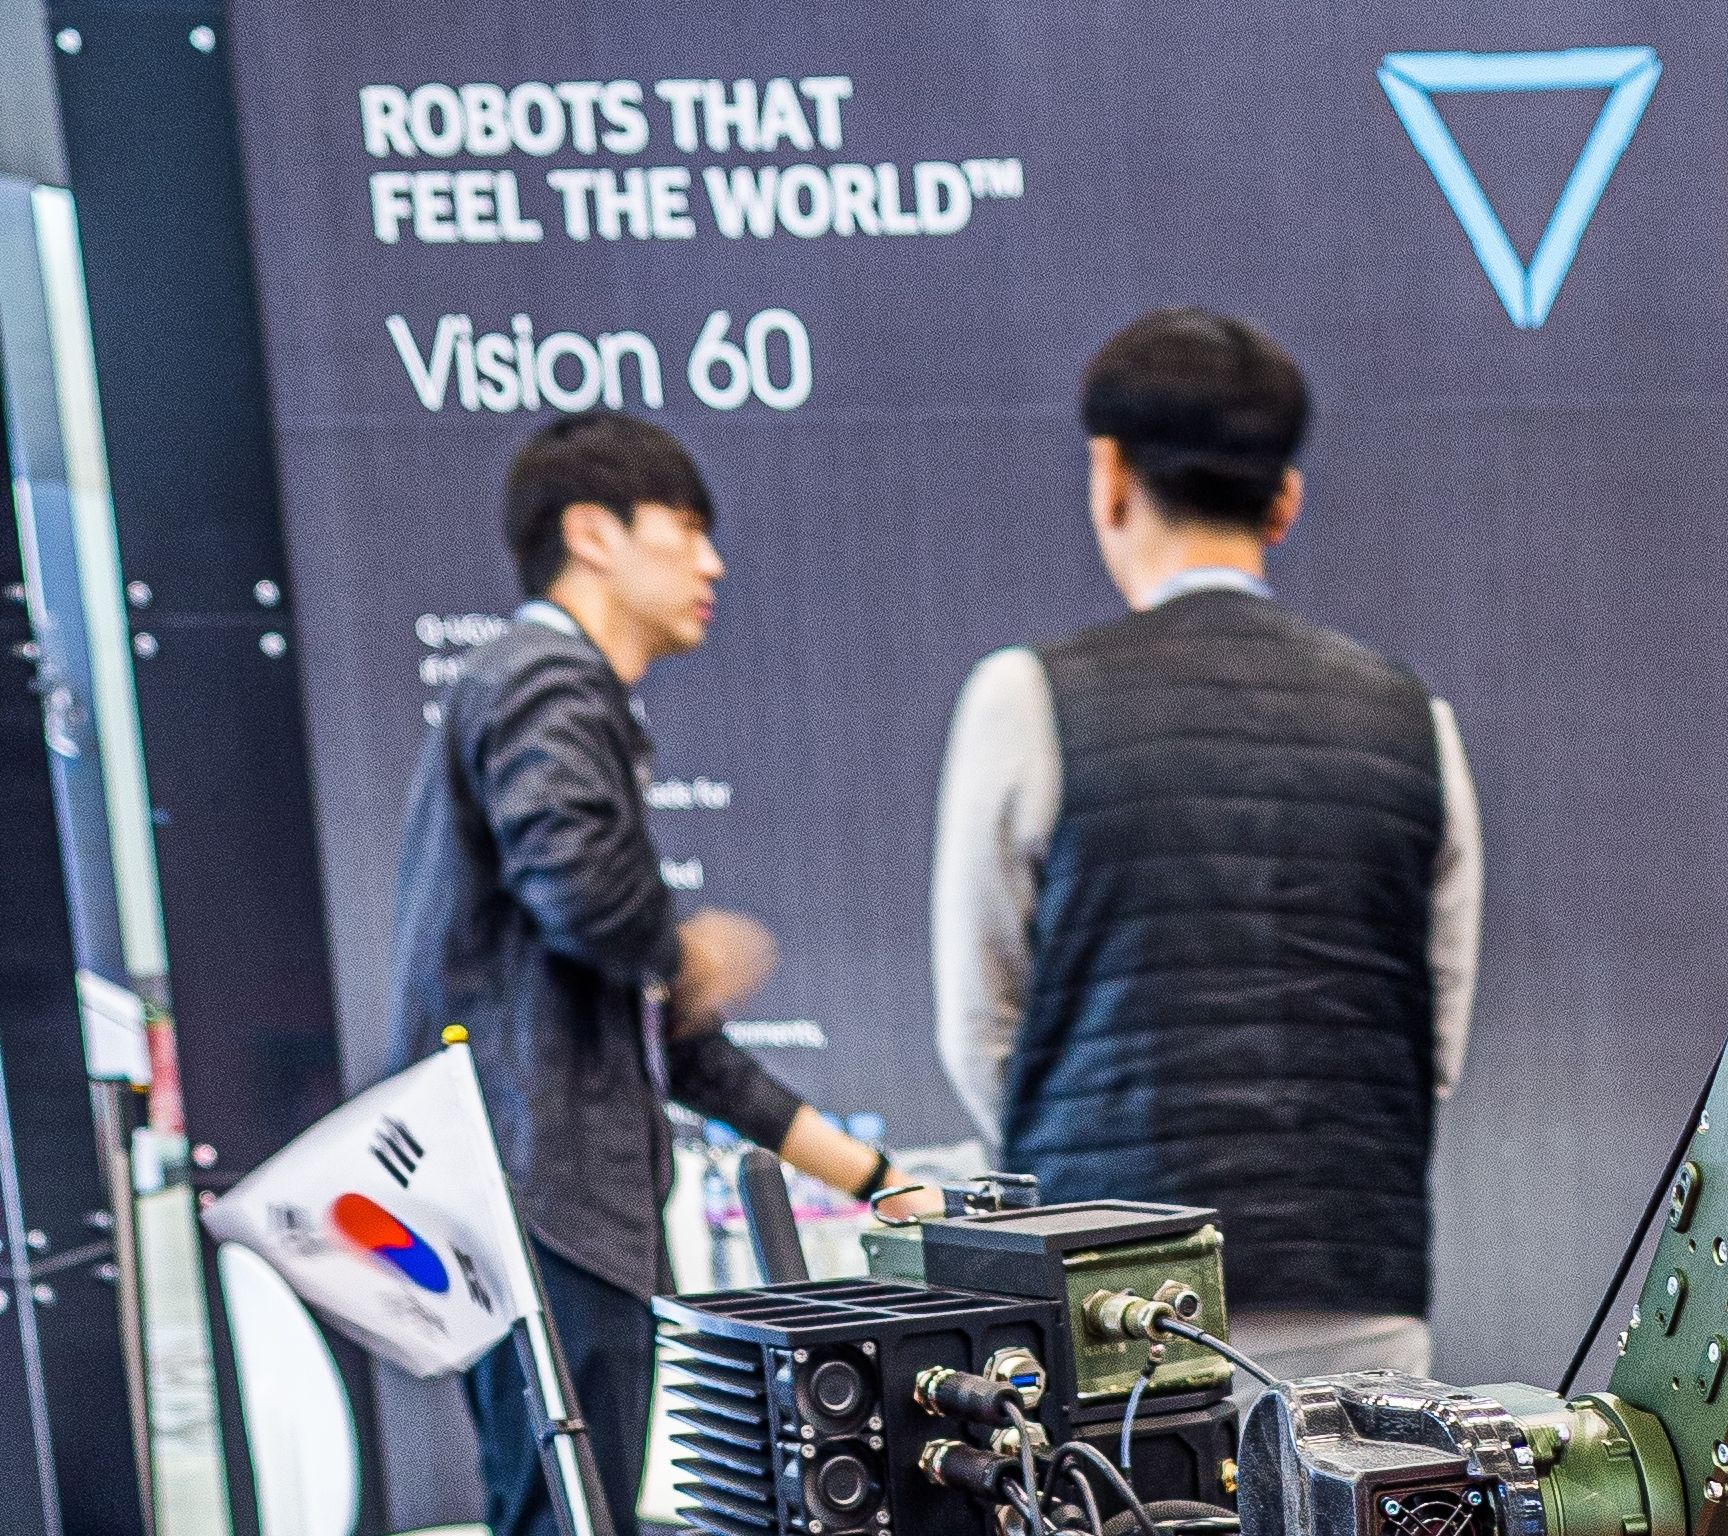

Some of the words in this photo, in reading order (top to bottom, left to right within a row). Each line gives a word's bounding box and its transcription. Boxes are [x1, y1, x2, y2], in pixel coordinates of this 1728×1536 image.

[359, 80, 649, 157] ROBOTS
[655, 76, 853, 152] THAT
[369, 170, 544, 244] FEEL
[547, 166, 696, 241] THE
[385, 312, 663, 412] Vision
[686, 308, 813, 411] 60
